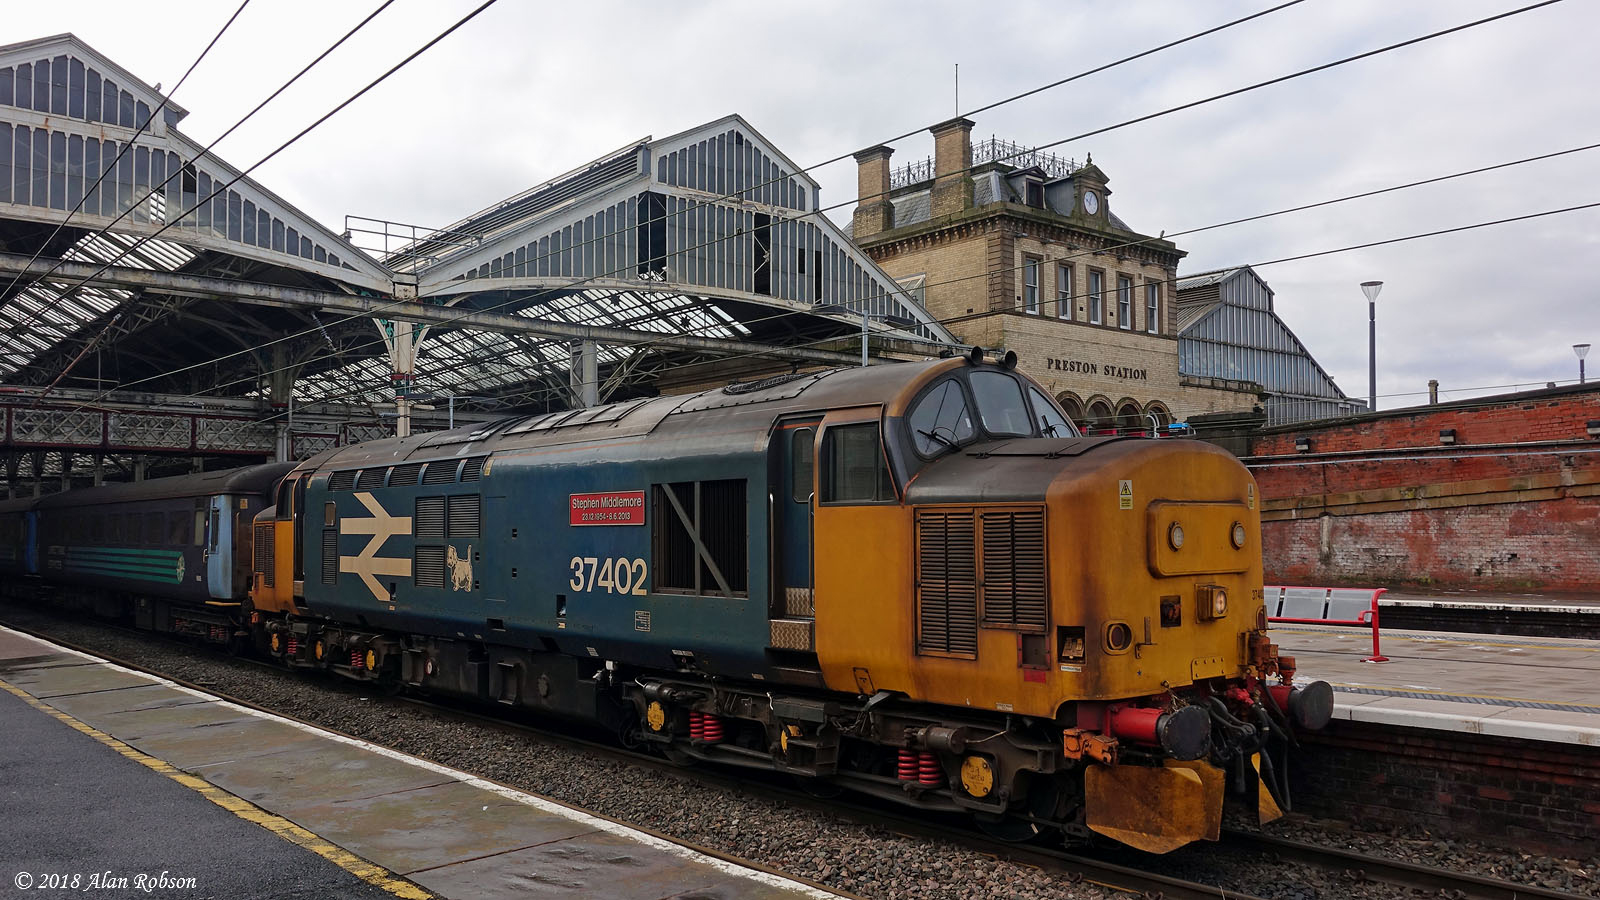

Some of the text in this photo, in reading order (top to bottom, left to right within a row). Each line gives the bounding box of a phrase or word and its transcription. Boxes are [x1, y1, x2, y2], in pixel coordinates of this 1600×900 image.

[1047, 358, 1147, 380] PRESTON STATION
[572, 496, 642, 510] Stephen Middlemore
[570, 556, 647, 596] 37402
